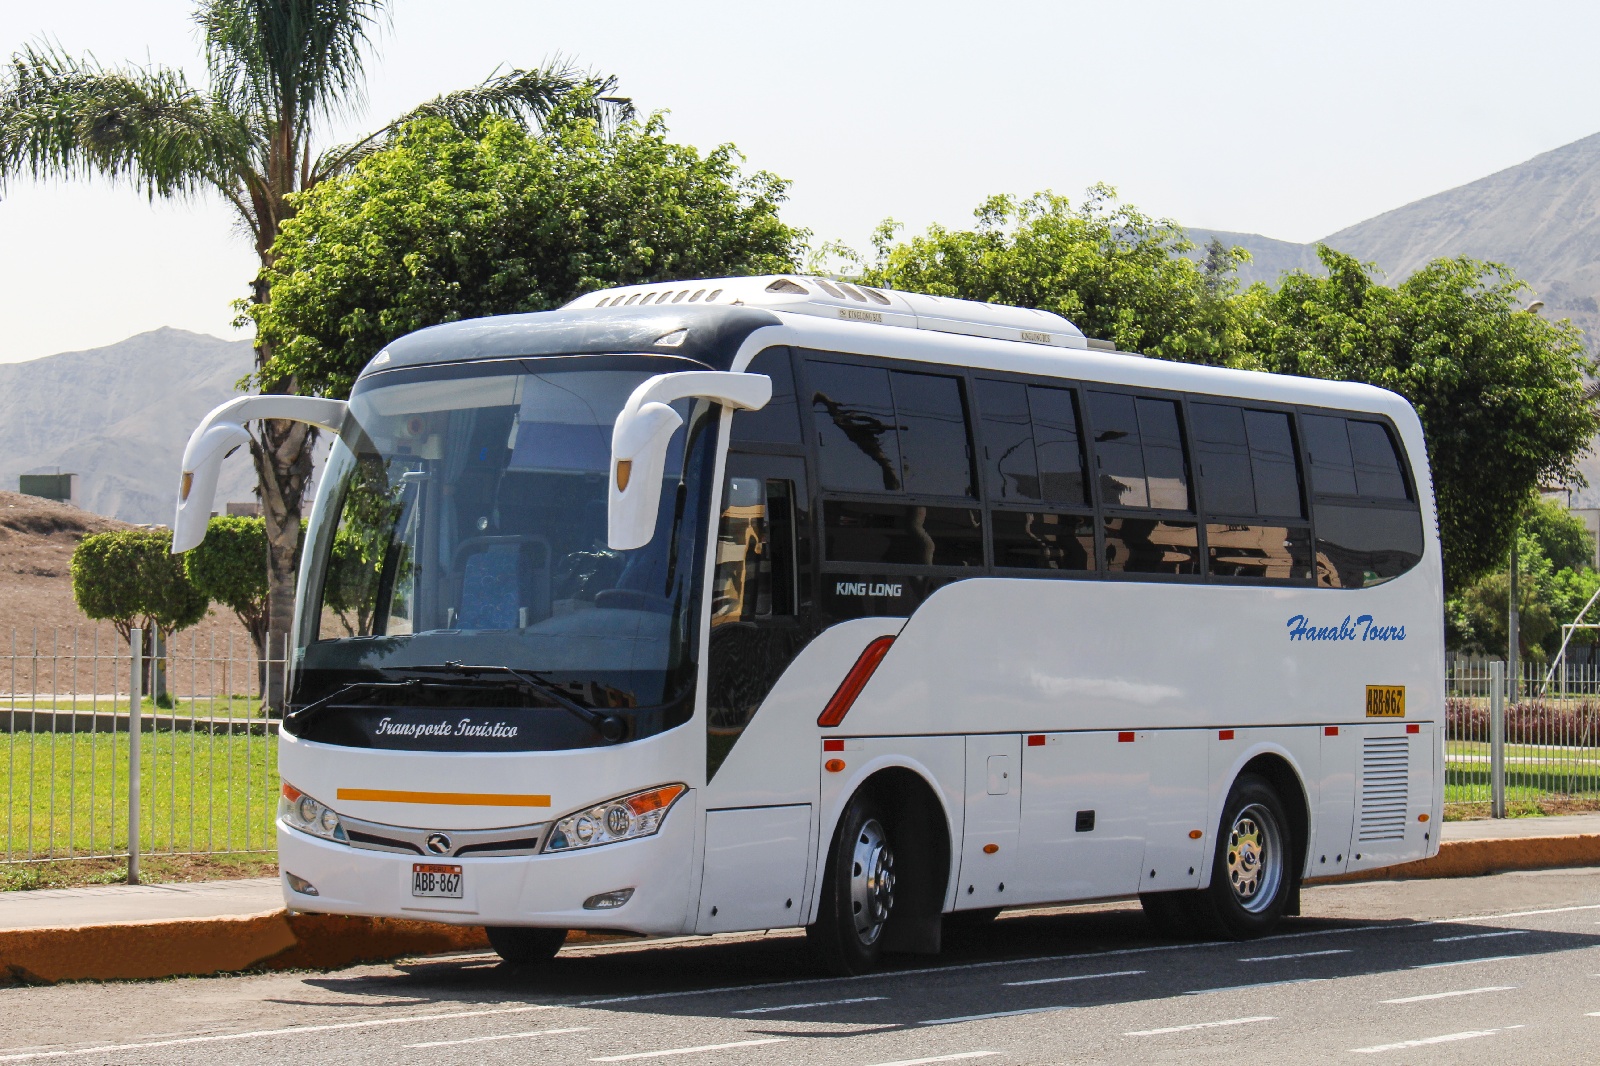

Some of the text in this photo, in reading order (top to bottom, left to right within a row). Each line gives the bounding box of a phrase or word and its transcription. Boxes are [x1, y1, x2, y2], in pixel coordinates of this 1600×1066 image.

[836, 582, 902, 597] KING LONG
[1286, 614, 1407, 641] Hanabi Tours
[1367, 688, 1403, 715] ABB-867
[375, 717, 518, 739] Transporte Turistico
[414, 872, 461, 893] ABB-867
